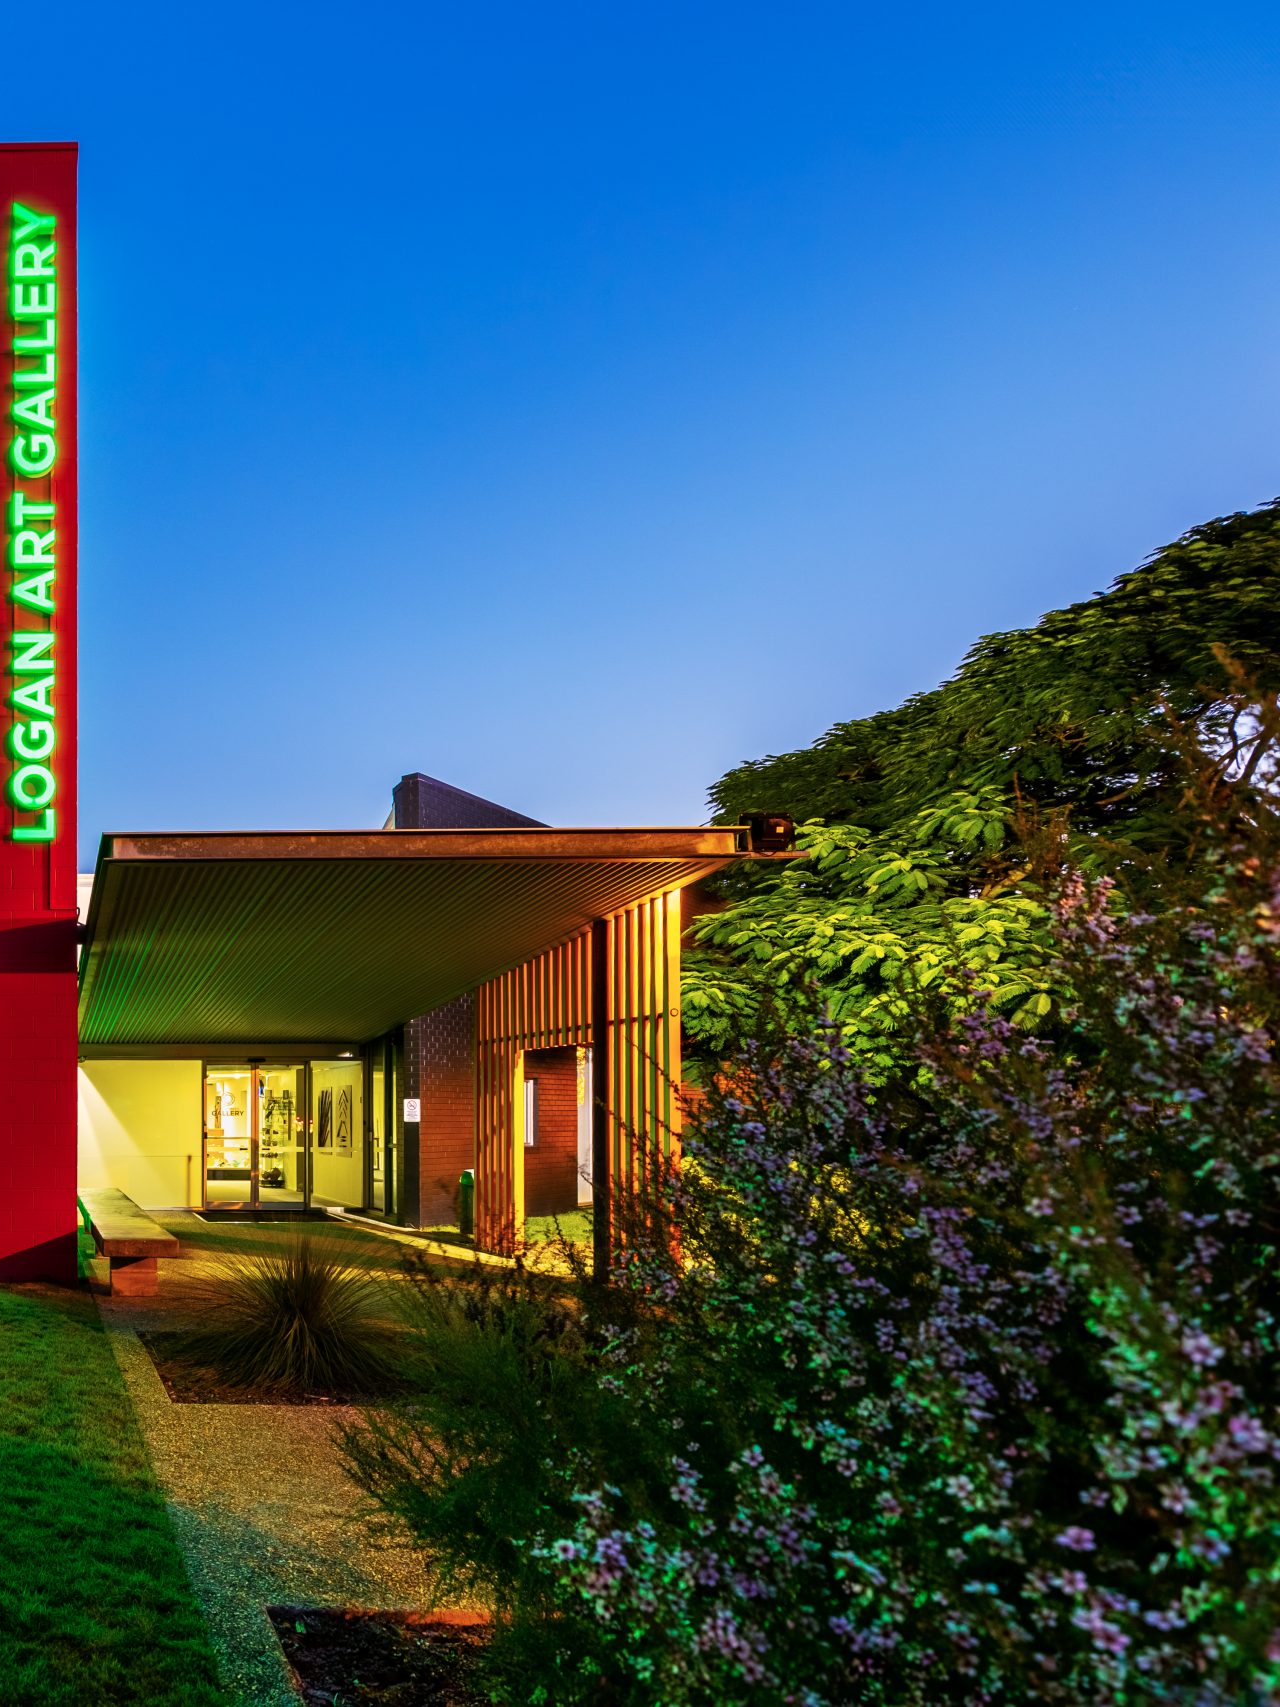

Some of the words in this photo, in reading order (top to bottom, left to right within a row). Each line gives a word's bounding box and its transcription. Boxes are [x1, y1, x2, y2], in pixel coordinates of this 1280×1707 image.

[12, 202, 56, 477] GALLERY
[12, 492, 56, 612] ART
[12, 632, 56, 841] LOGAN
